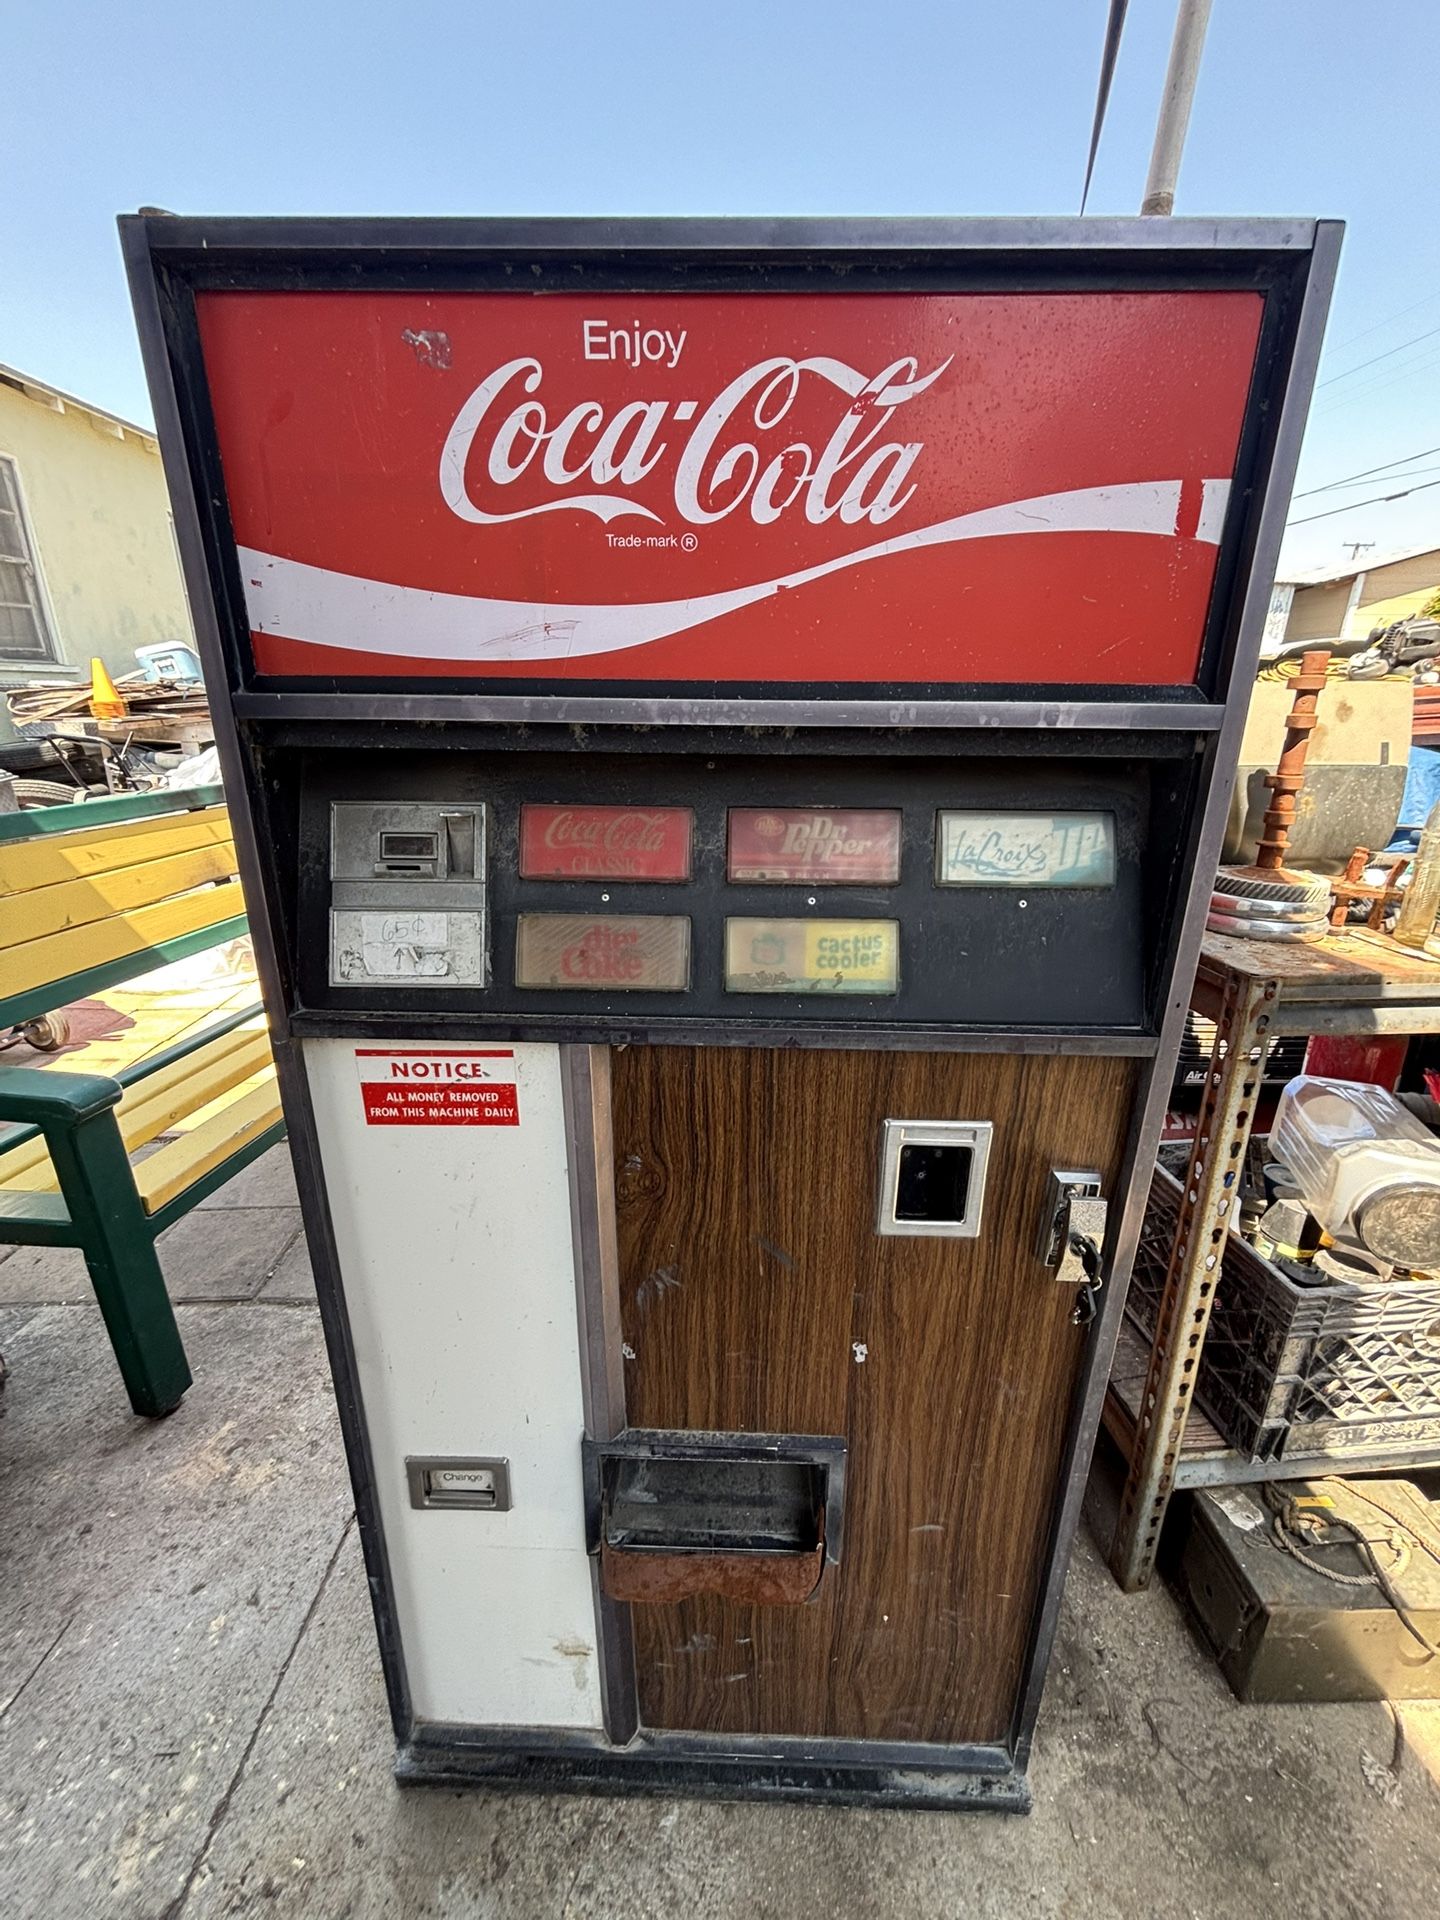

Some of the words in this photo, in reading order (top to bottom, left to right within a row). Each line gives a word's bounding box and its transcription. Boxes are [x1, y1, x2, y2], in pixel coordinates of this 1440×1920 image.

[583, 320, 687, 368] Enjoy
[439, 354, 954, 525] Coca-Cola
[605, 533, 678, 548] Trade-mark
[809, 816, 848, 840] Dr
[780, 823, 872, 862] Pepper
[817, 934, 883, 953] cactus
[816, 951, 882, 969] cooler
[391, 1062, 482, 1078] NOTICE
[386, 1092, 404, 1102] ALL
[408, 1092, 445, 1103] MONEY
[450, 1092, 499, 1103] REMOVED
[370, 1107, 399, 1117] FROM
[403, 1107, 425, 1117] THIS
[429, 1107, 479, 1118] MACHINE
[485, 1107, 514, 1118] DAILY
[442, 1472, 483, 1482] Change
